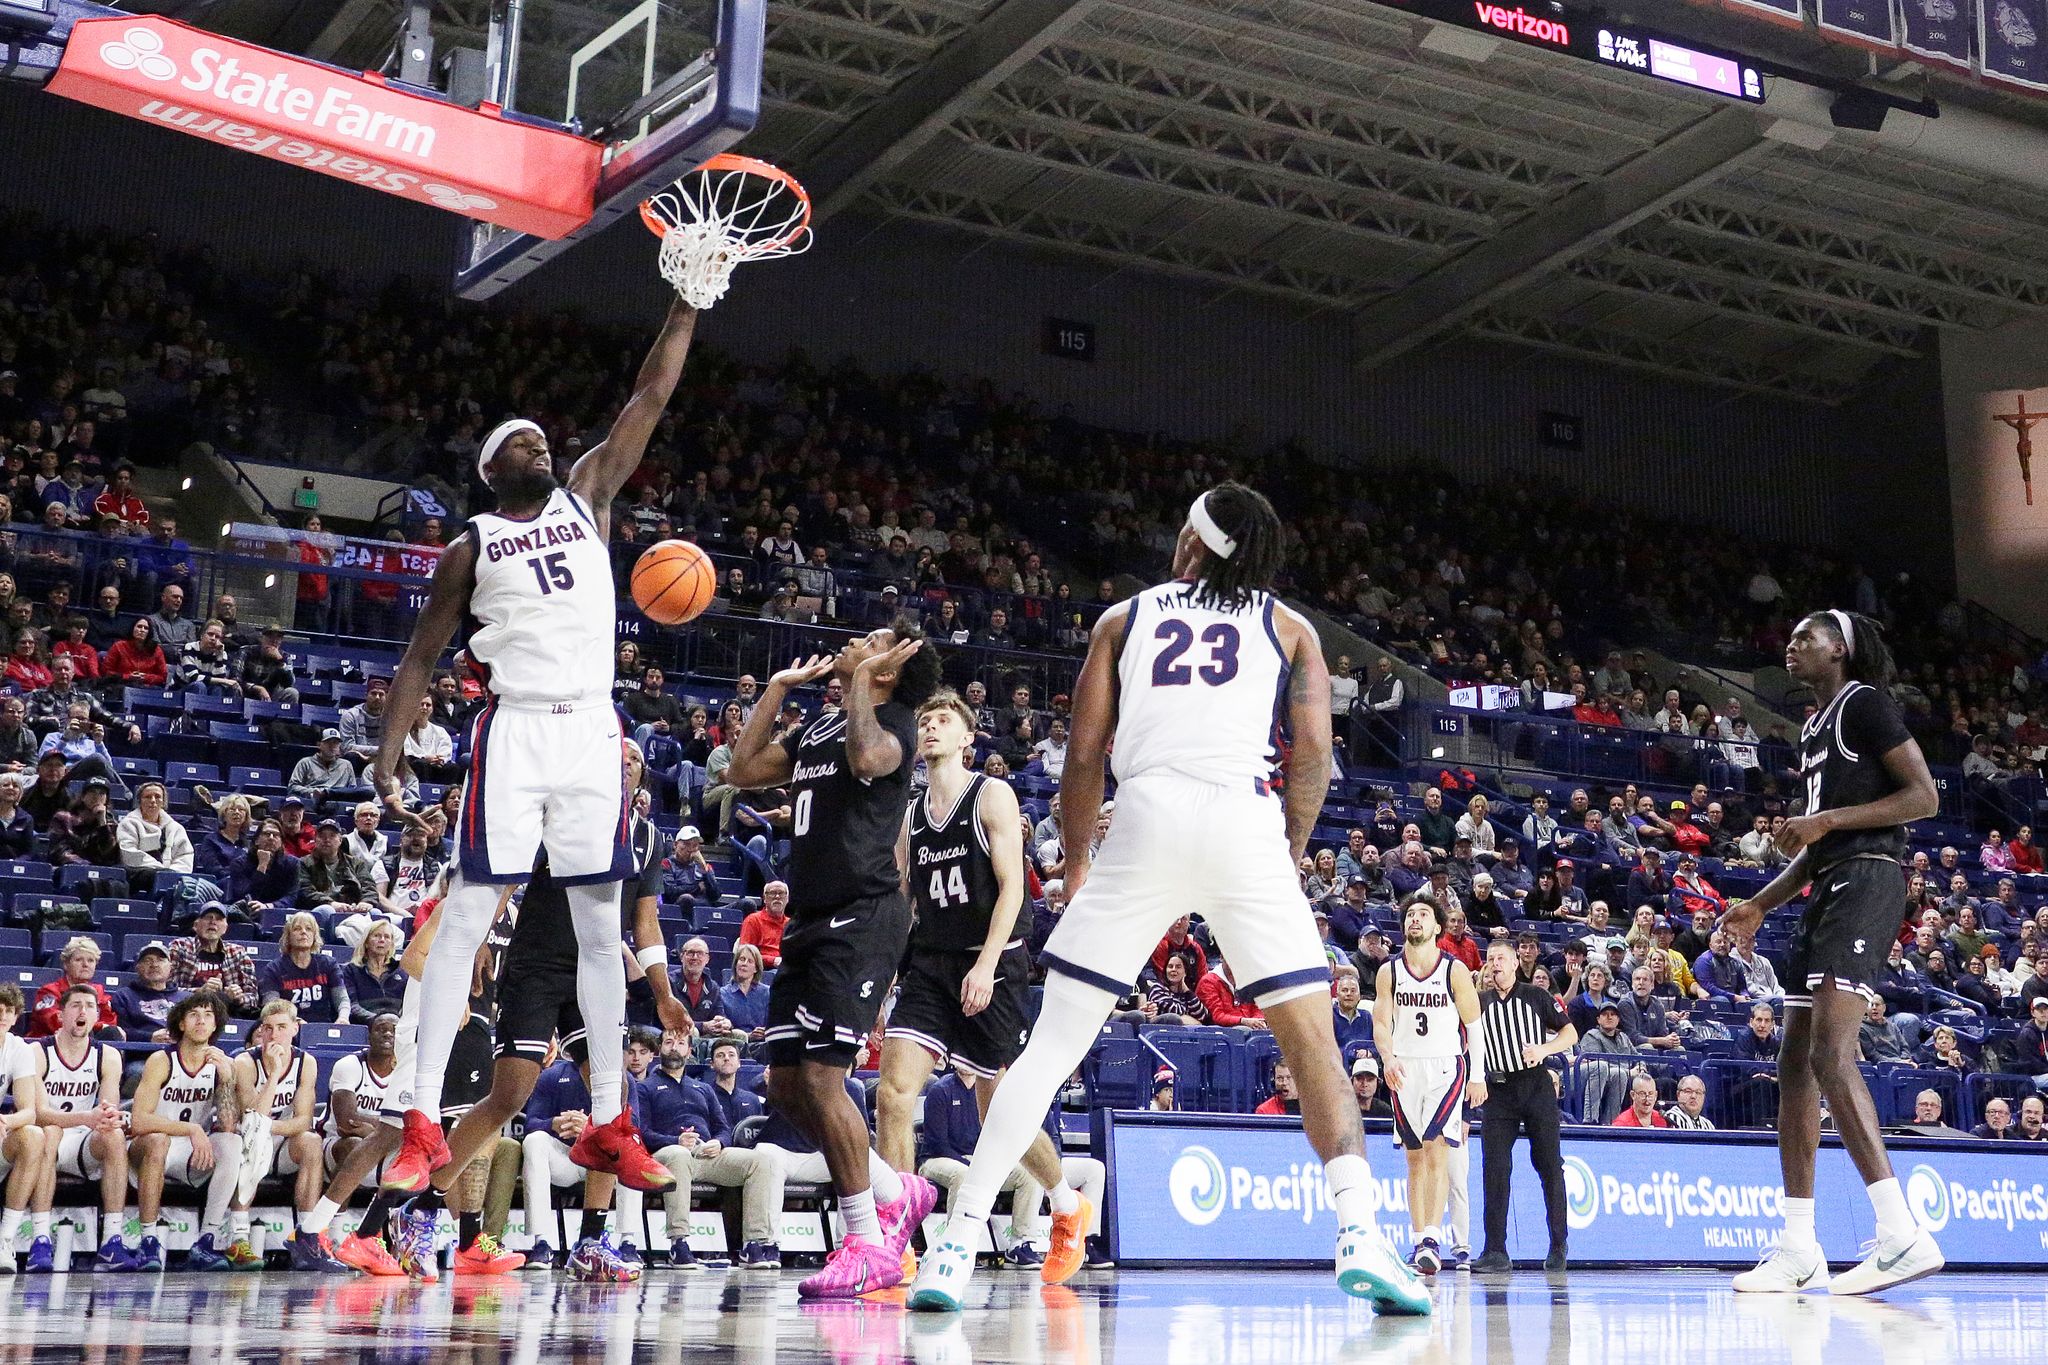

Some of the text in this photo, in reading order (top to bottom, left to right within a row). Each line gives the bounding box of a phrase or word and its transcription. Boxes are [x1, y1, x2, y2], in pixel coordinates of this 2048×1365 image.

[1475, 1, 1569, 45] verizon
[1716, 67, 1727, 84] 4
[181, 48, 436, 157] State Farm
[1060, 330, 1085, 350] 115
[1552, 422, 1573, 440] 116
[486, 521, 587, 563] GONZAGA
[527, 551, 575, 595] 15
[409, 594, 429, 608] 11
[617, 620, 640, 635] 114
[1152, 619, 1241, 687] 23
[551, 704, 573, 714] ZAGS
[1439, 719, 1457, 731] 115
[794, 789, 813, 836] 0
[917, 845, 968, 866] Broncos
[928, 865, 969, 908] 44
[291, 984, 323, 1004] ZAG
[1395, 992, 1448, 1008] GONZAGA
[1415, 1012, 1429, 1036] 3
[1601, 1170, 1787, 1229] PacificSource
[1950, 1178, 2048, 1232] PacificS
[782, 1226, 814, 1236] ICCU
[1703, 1227, 1753, 1247] HEALTH
